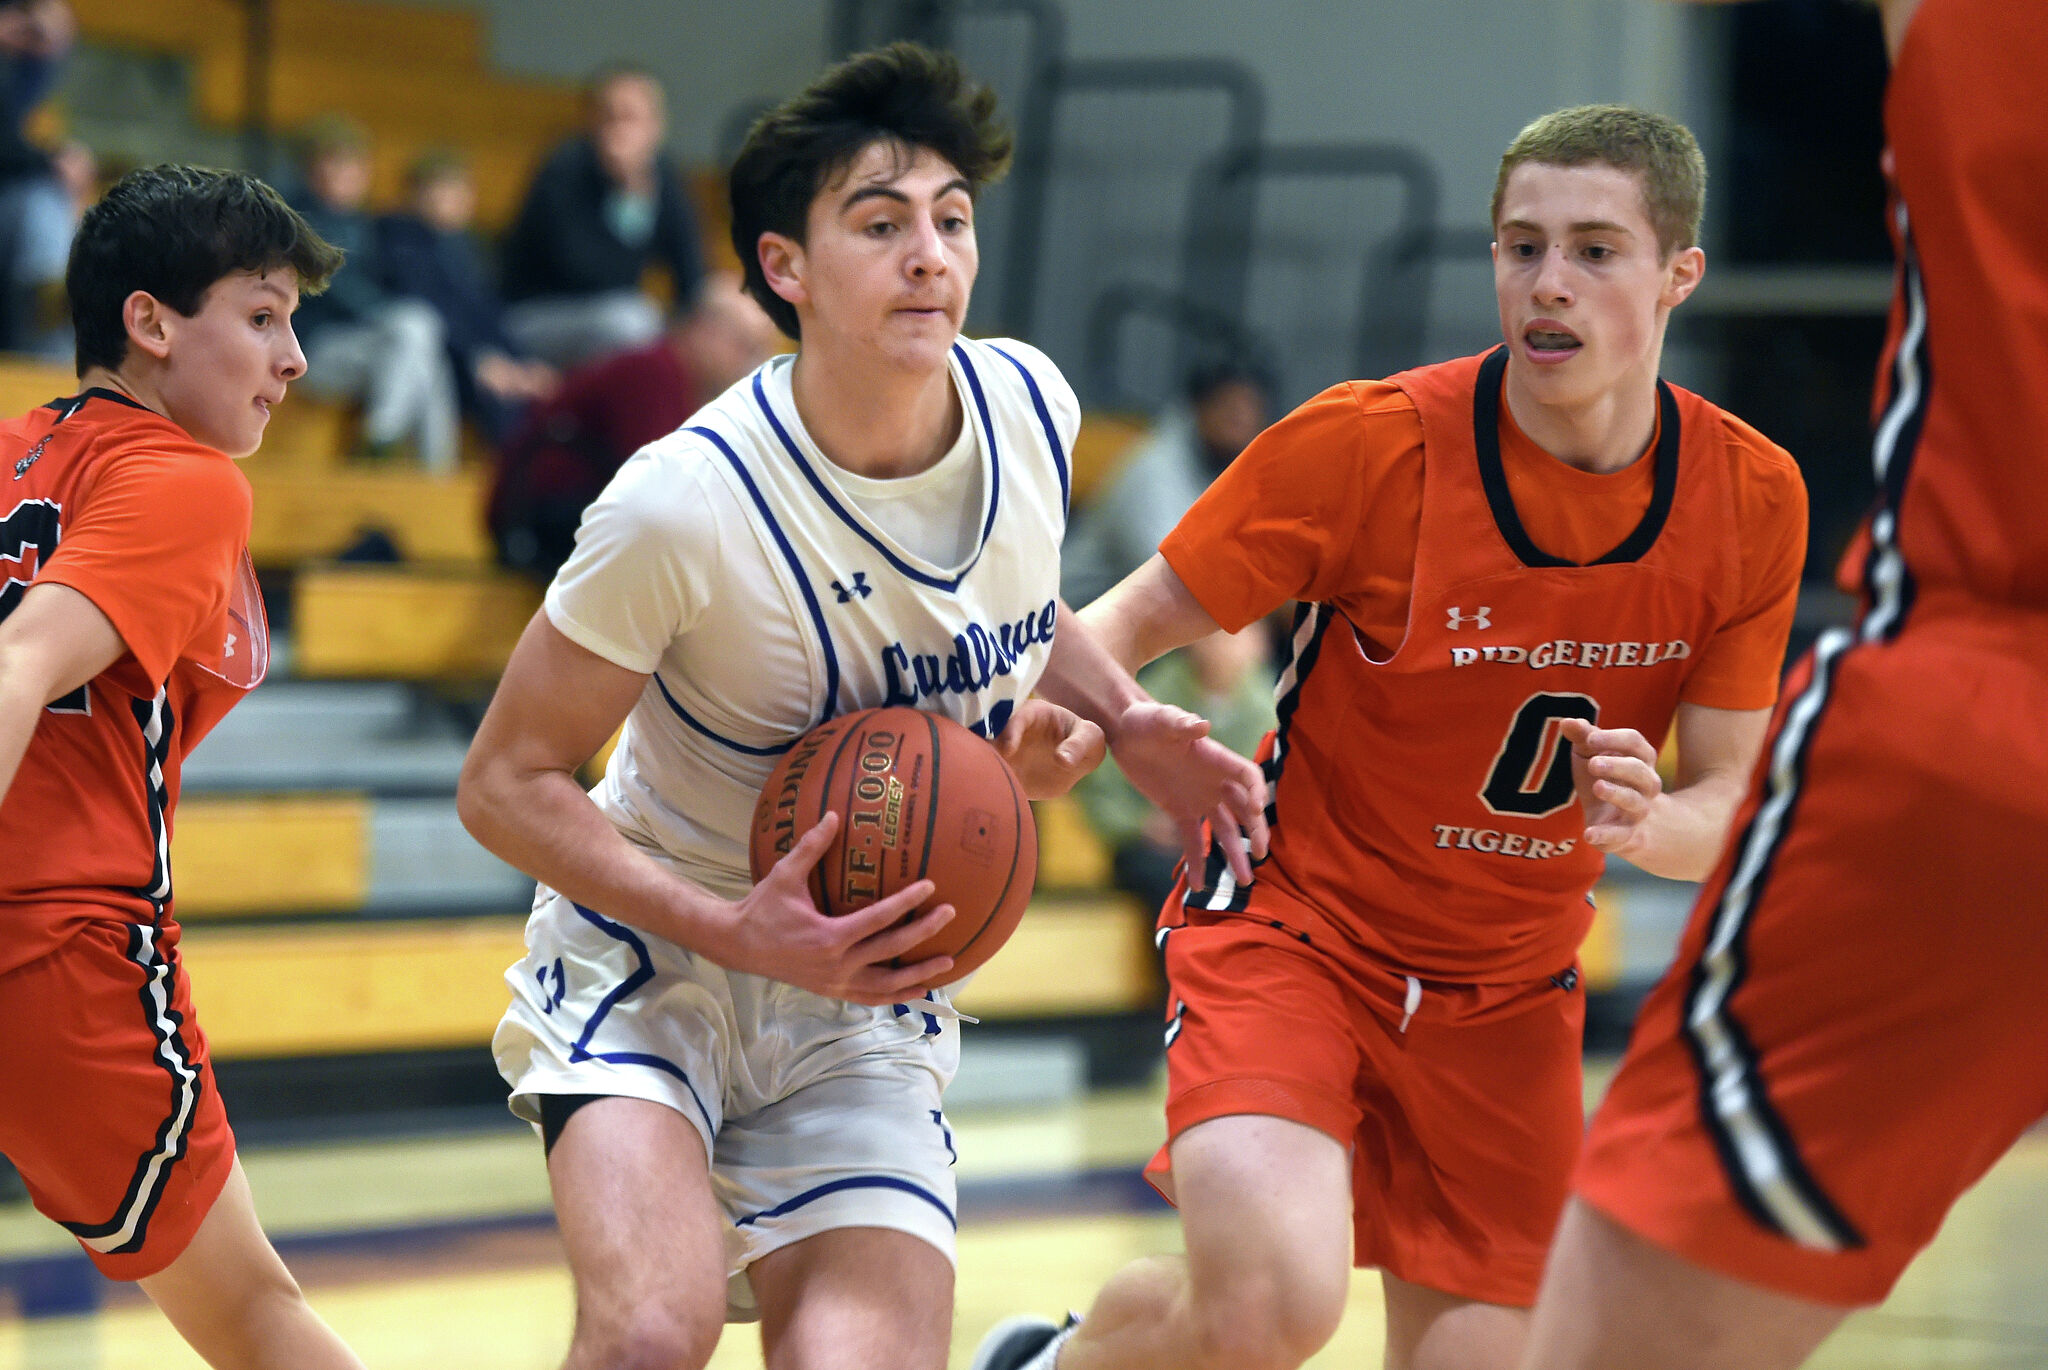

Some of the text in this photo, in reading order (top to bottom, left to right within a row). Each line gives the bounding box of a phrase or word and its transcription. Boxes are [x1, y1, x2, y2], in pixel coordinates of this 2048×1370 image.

[1450, 639, 1691, 669] RIDGEFIELD
[847, 730, 896, 904] TF-1000
[882, 775, 905, 850] LEGACY
[1432, 823, 1577, 860] TIGERS
